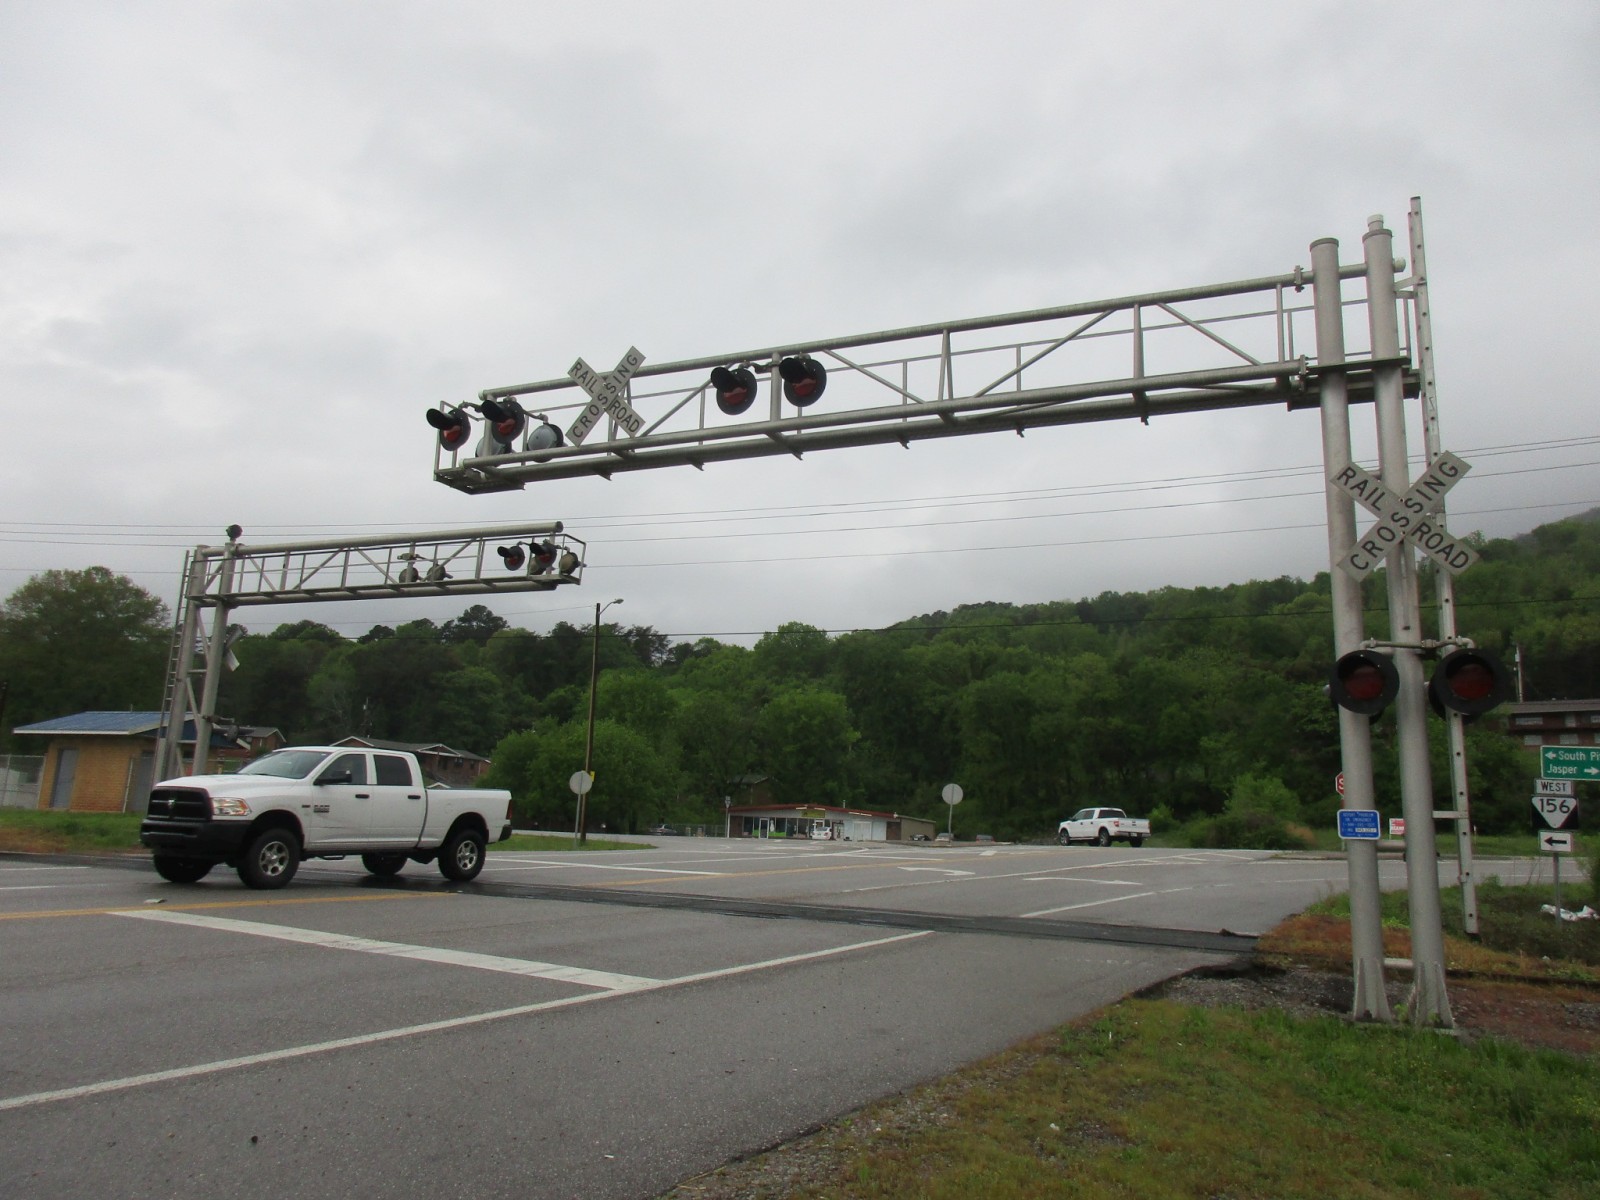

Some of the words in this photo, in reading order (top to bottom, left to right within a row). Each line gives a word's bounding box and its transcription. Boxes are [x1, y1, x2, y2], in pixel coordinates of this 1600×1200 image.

[571, 362, 598, 394] RAIL
[609, 400, 640, 433] ROAD
[572, 354, 638, 438] CROSSING
[1336, 466, 1386, 512] RAIL
[1411, 522, 1469, 569] ROAD
[1350, 461, 1459, 570] CROSSING
[1547, 764, 1578, 776] Jasper
[1558, 751, 1586, 761] South
[1539, 798, 1571, 814] 156
[1540, 782, 1567, 792] WEST
